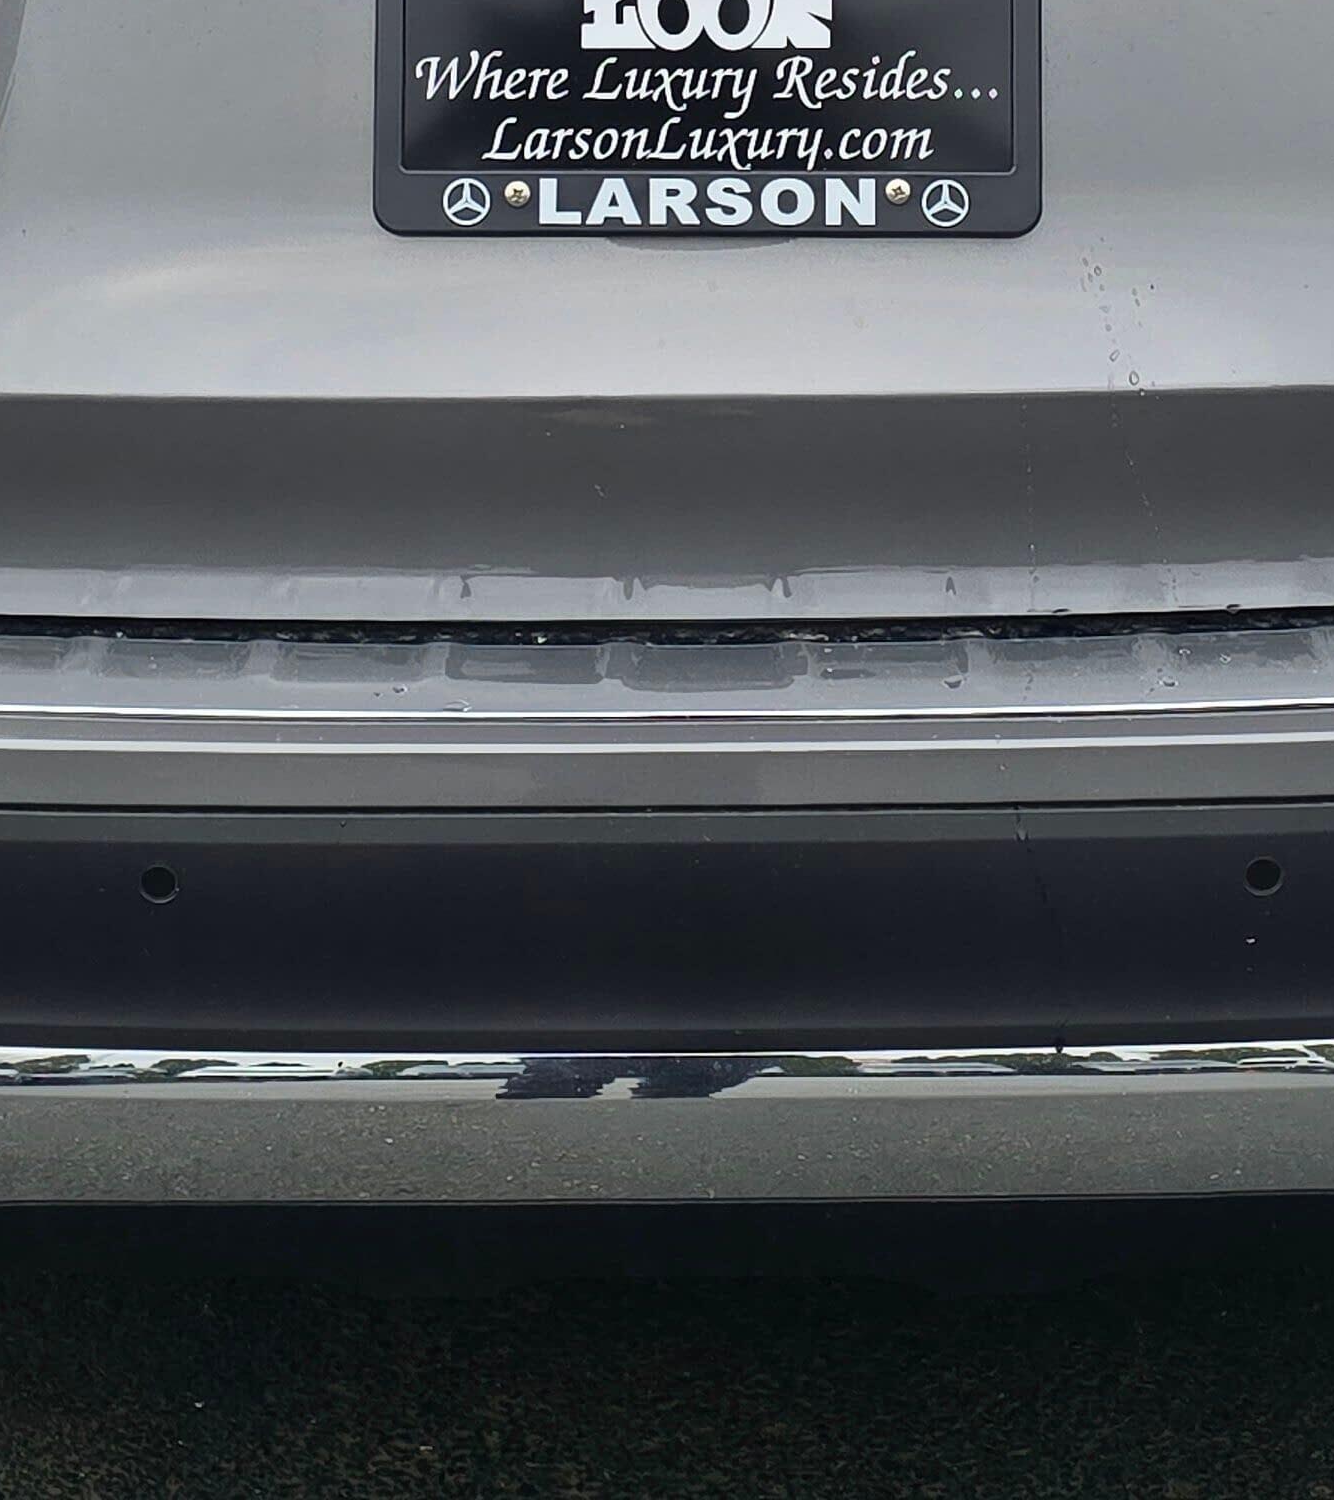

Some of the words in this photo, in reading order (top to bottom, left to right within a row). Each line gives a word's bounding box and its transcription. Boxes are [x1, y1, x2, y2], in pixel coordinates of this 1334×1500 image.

[414, 50, 570, 101] Where
[582, 56, 756, 119] Luxury
[481, 116, 935, 171] LarsonLuxury.com
[537, 177, 878, 226] LARSON
